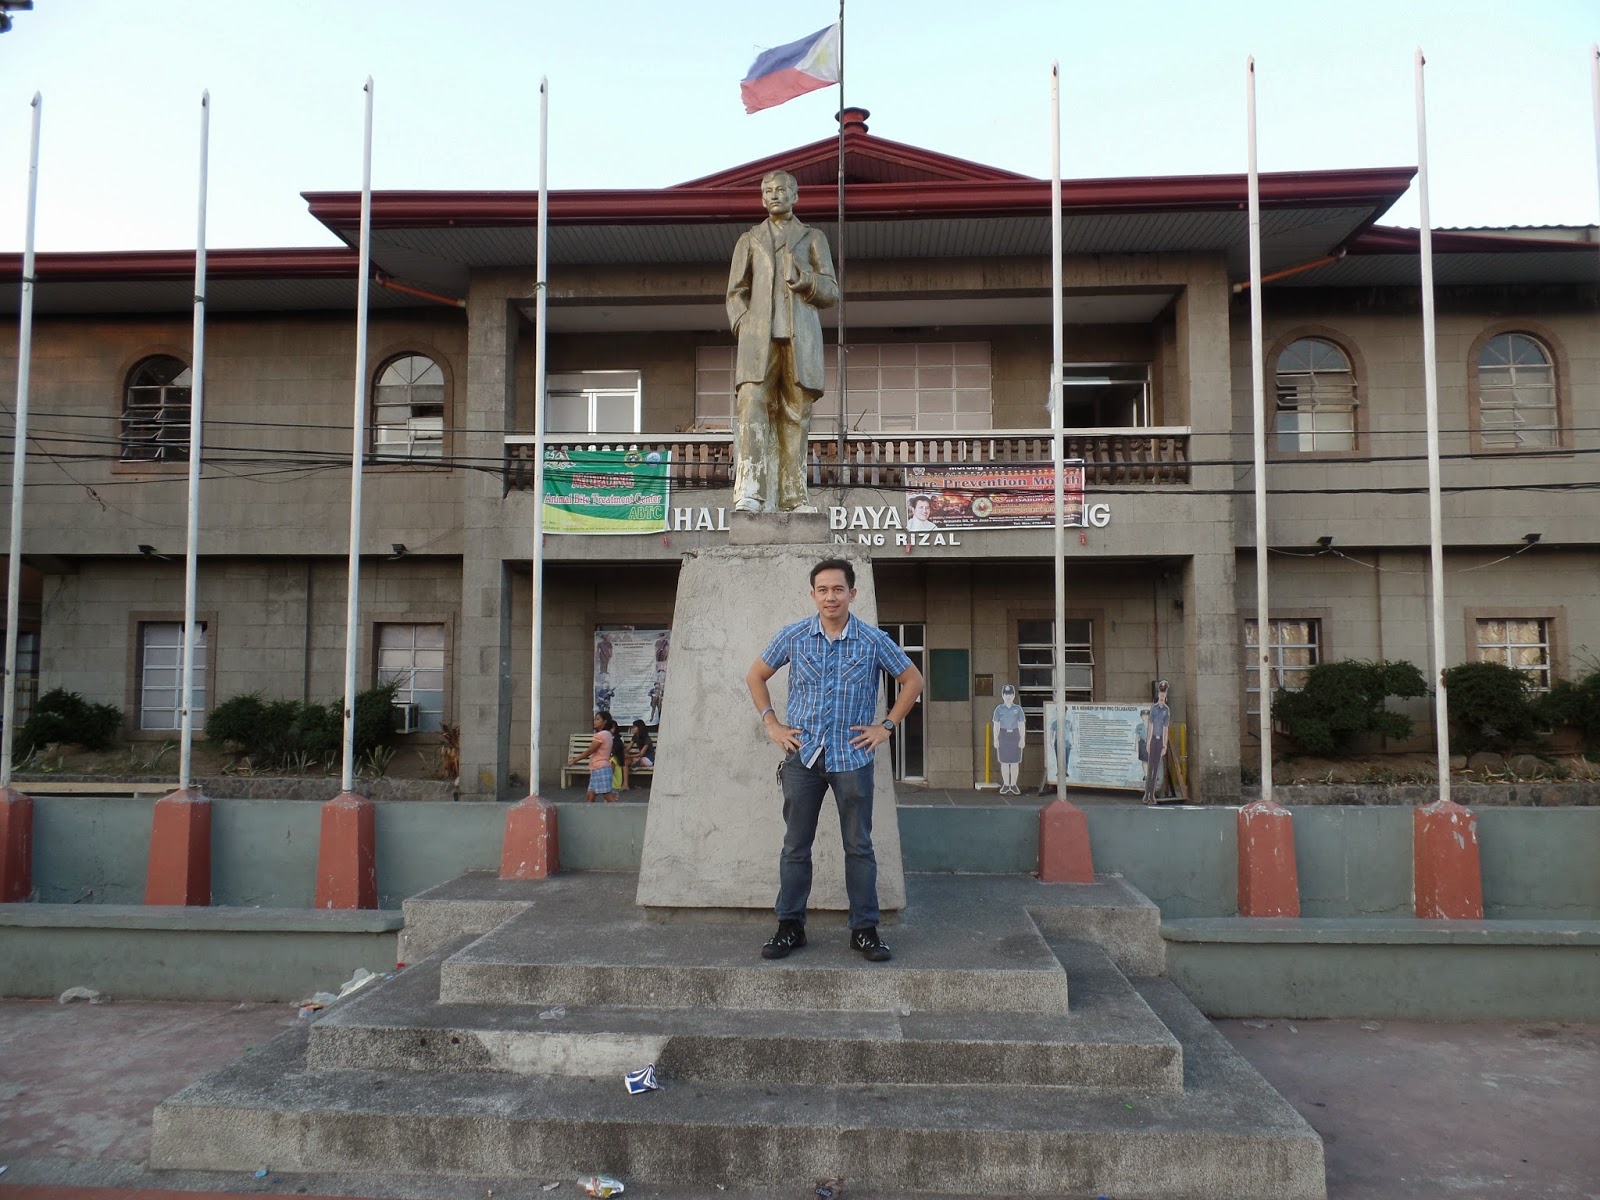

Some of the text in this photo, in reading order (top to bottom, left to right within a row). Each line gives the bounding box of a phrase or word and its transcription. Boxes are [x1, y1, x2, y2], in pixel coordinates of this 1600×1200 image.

[944, 477, 1027, 488] Prevention
[1033, 476, 1080, 486] Moth
[544, 493, 662, 504] Animal Bite Treatment Center
[628, 506, 662, 519] ABTC
[667, 507, 730, 531] HAL
[859, 533, 885, 546] NG
[896, 533, 961, 546] RIZAL
